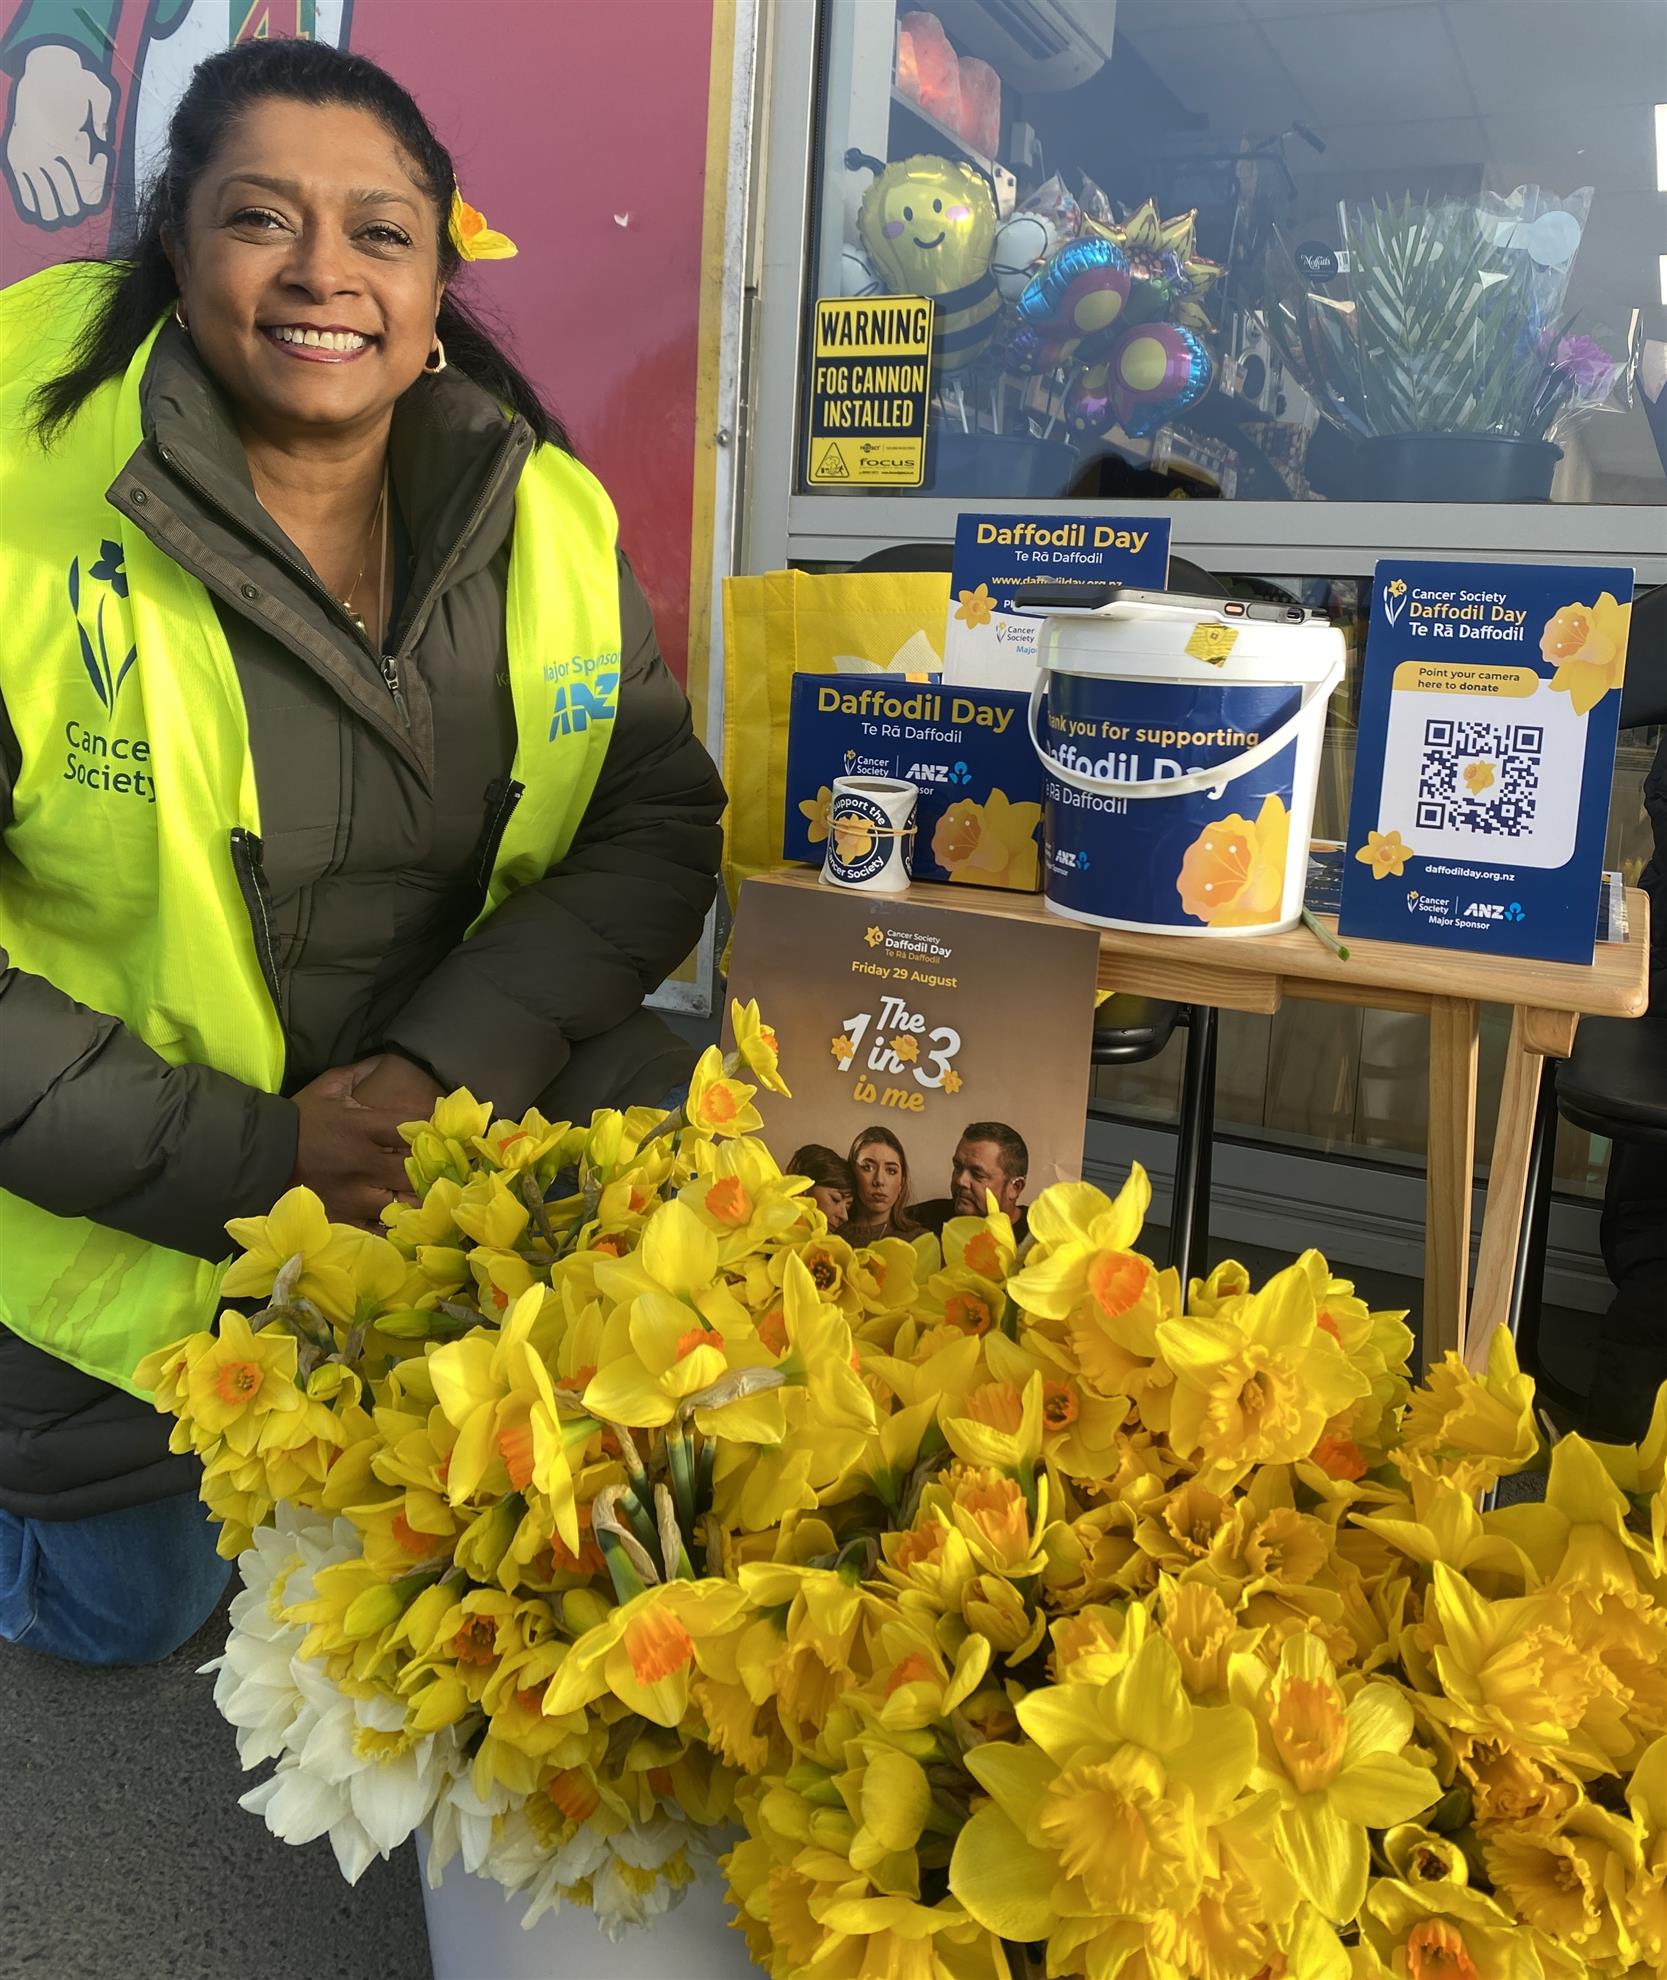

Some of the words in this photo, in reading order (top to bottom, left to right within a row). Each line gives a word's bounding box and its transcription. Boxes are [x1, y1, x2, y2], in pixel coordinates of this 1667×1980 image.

[821, 308, 927, 346] WARNING
[817, 367, 848, 394] FOG
[852, 365, 924, 394] CANNON
[823, 400, 914, 428] INSTALLED
[860, 458, 915, 466] focus
[977, 523, 1086, 547] Daffodil
[1094, 526, 1149, 554] Day
[1015, 551, 1028, 562] Te
[1032, 551, 1049, 562] Rā
[1052, 552, 1103, 564] Daffodil
[1411, 588, 1457, 601] Cancer
[1459, 590, 1507, 605] Society
[1409, 602, 1484, 621] Daffodil
[1491, 603, 1527, 626] Day
[1007, 634, 1035, 643] Society
[1008, 626, 1035, 635] Cancer
[1409, 622, 1428, 637] Te
[1433, 622, 1454, 638] Rā
[1459, 624, 1524, 641] Daffodil
[1016, 646, 1036, 655] Majo
[1419, 667, 1448, 678] Point
[1450, 670, 1476, 681] your
[1478, 672, 1520, 682] camera
[1417, 680, 1442, 690] here
[1444, 681, 1457, 690] to
[1459, 682, 1500, 693] donate
[548, 672, 620, 742] ANZ
[818, 687, 940, 721] Daffodil
[951, 699, 1015, 733] Day
[65, 720, 150, 762] Cance
[861, 722, 878, 735] Te
[881, 724, 901, 738] Rā
[905, 726, 962, 743] Daffodil
[1047, 712, 1066, 732] ank
[1069, 720, 1096, 737] you
[1101, 721, 1130, 740] for
[1136, 728, 1260, 748] supporting
[856, 765, 889, 778] Society
[857, 755, 889, 767] Cancer
[905, 763, 949, 783] ANZ
[1047, 740, 1139, 782] affodil
[63, 752, 156, 803] Society
[1062, 787, 1127, 815] Daffodil
[869, 806, 885, 825] the
[828, 846, 846, 876] ancer
[847, 856, 885, 879] Society
[1055, 849, 1077, 868] ANZ
[1425, 864, 1515, 882] daffodilday.org.nz
[1418, 903, 1450, 915] Society
[1419, 895, 1450, 906] Cancer
[1463, 902, 1504, 920] ANZ
[1428, 916, 1454, 927] Major
[1455, 918, 1490, 930] Sponsor
[885, 938, 928, 953] Daffodil
[930, 944, 952, 958] Day
[887, 930, 912, 940] Cancer
[913, 933, 941, 944] Society
[885, 948, 895, 957] Te
[908, 952, 940, 964] Daffodil
[851, 960, 890, 979] Friday
[892, 967, 908, 979] 29
[910, 971, 958, 988] August
[876, 995, 926, 1033] The
[837, 1013, 872, 1072] 1
[867, 1035, 905, 1074] in
[912, 1026, 961, 1088] 3
[853, 1074, 877, 1104] is
[880, 1087, 925, 1112] me
